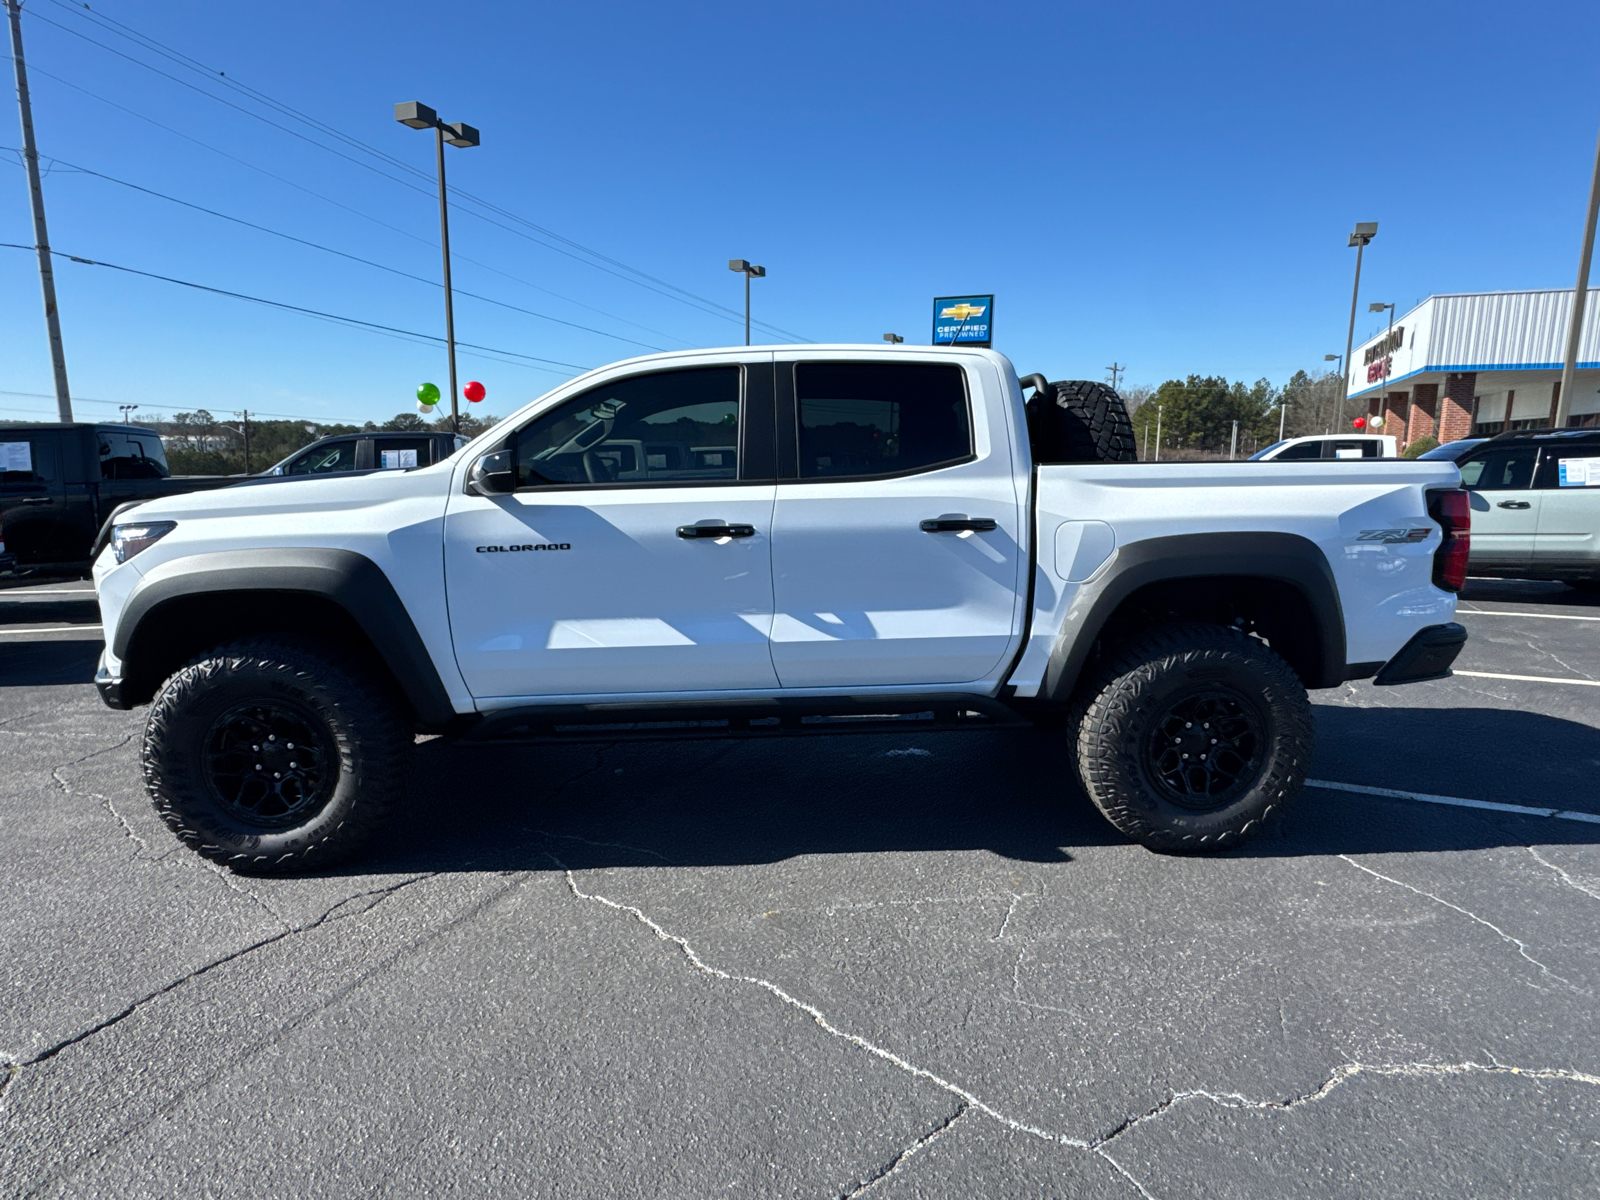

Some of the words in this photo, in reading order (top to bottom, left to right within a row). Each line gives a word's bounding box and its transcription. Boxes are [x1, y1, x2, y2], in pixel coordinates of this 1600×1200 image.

[937, 325, 987, 333] CERTIFIED
[1356, 528, 1433, 542] ZR2
[476, 543, 571, 553] COLORADO
